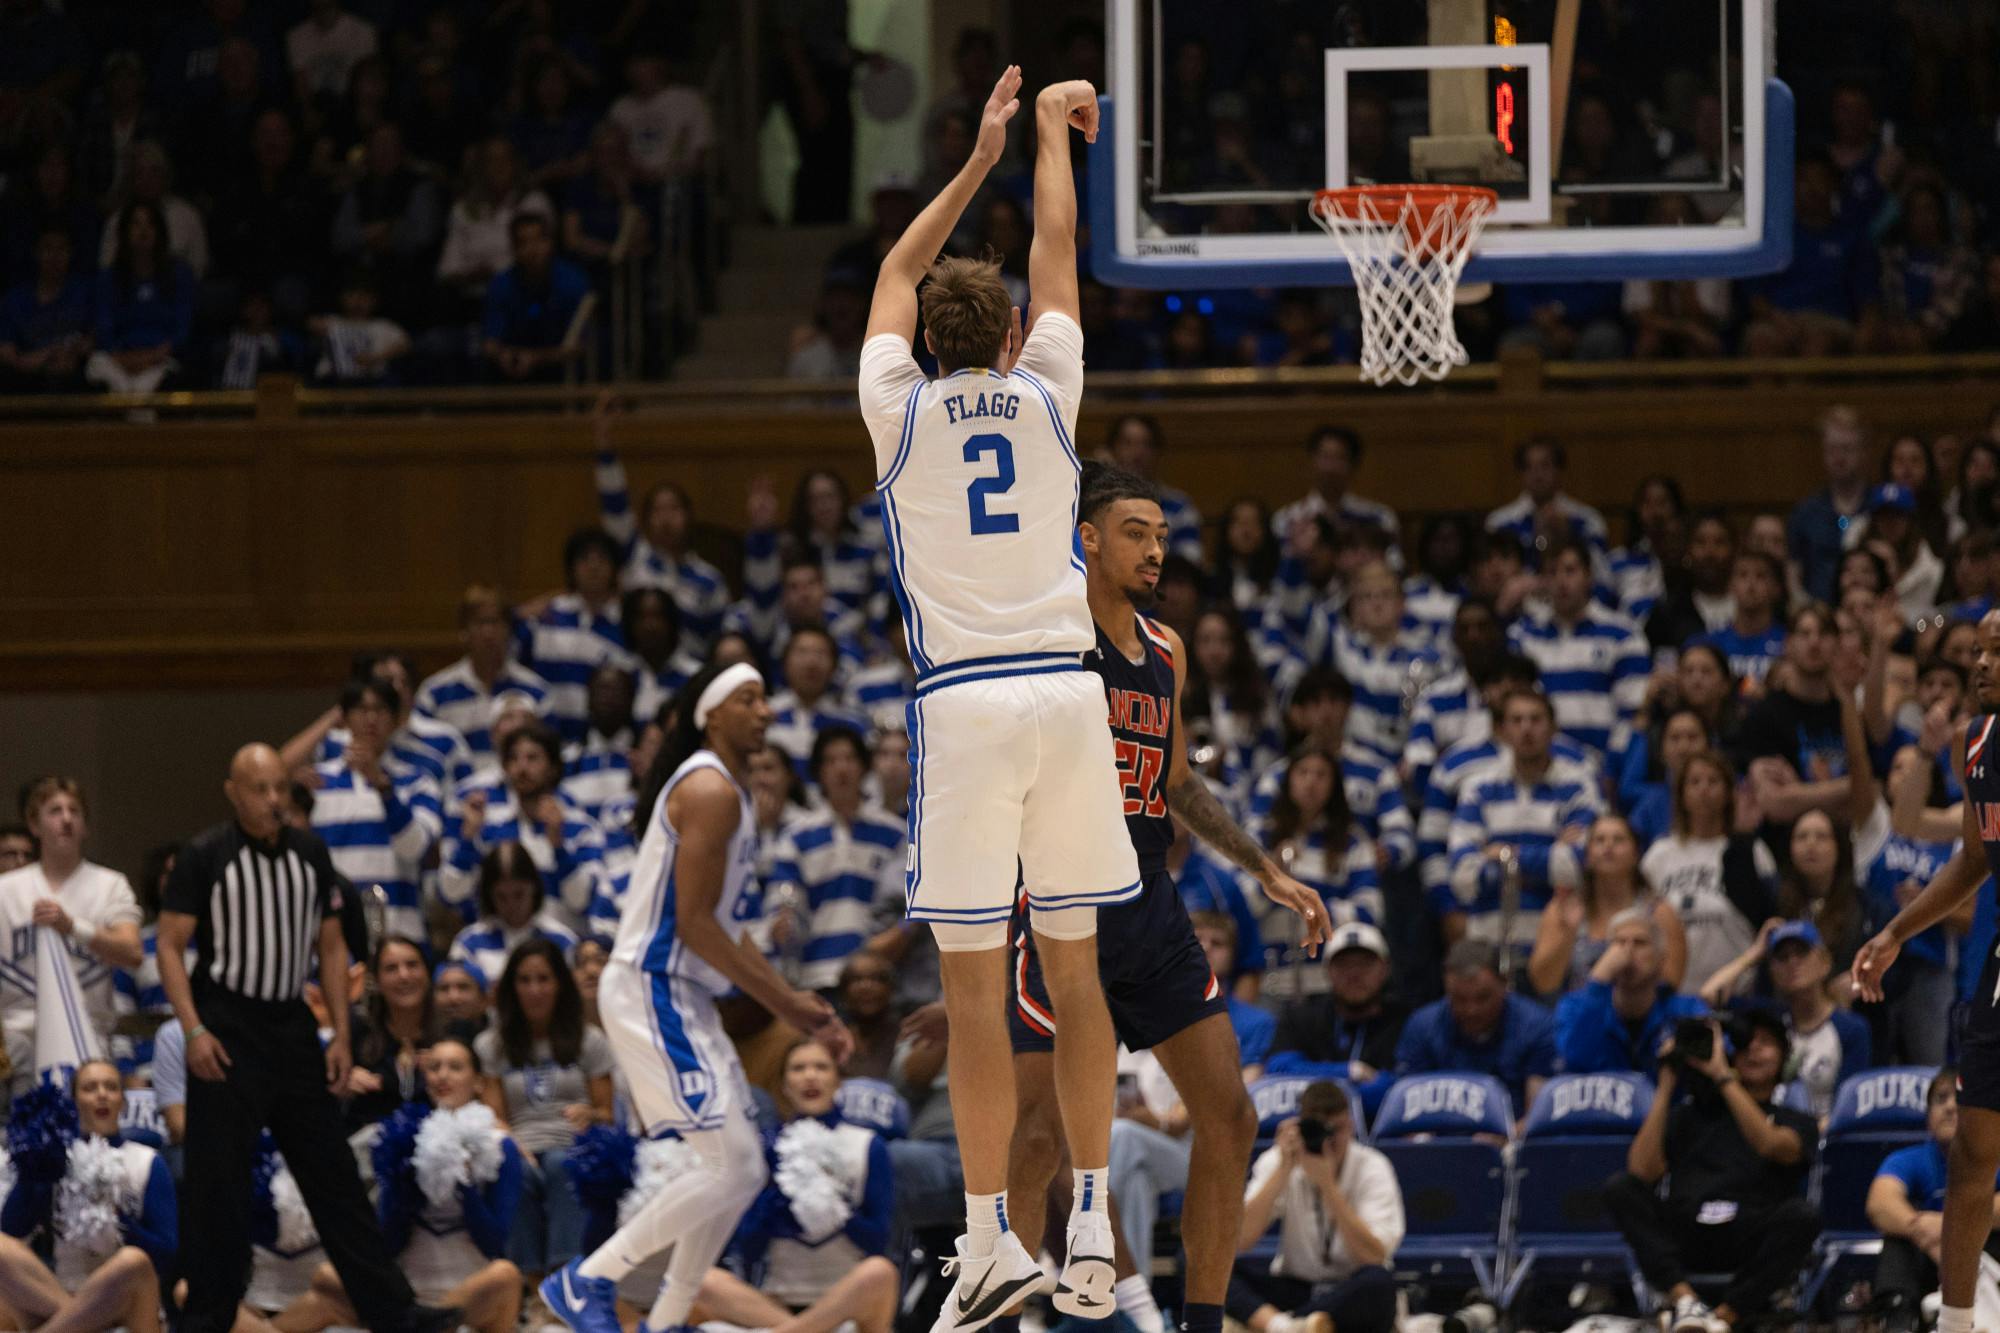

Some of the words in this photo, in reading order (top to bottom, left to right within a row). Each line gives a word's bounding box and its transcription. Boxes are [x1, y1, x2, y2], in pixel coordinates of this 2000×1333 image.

[944, 392, 1020, 424] FLAGG
[962, 433, 1020, 536] 2
[1255, 1080, 1309, 1122] DU
[1404, 1078, 1486, 1122] DUKE
[1552, 1075, 1635, 1121] DUKE
